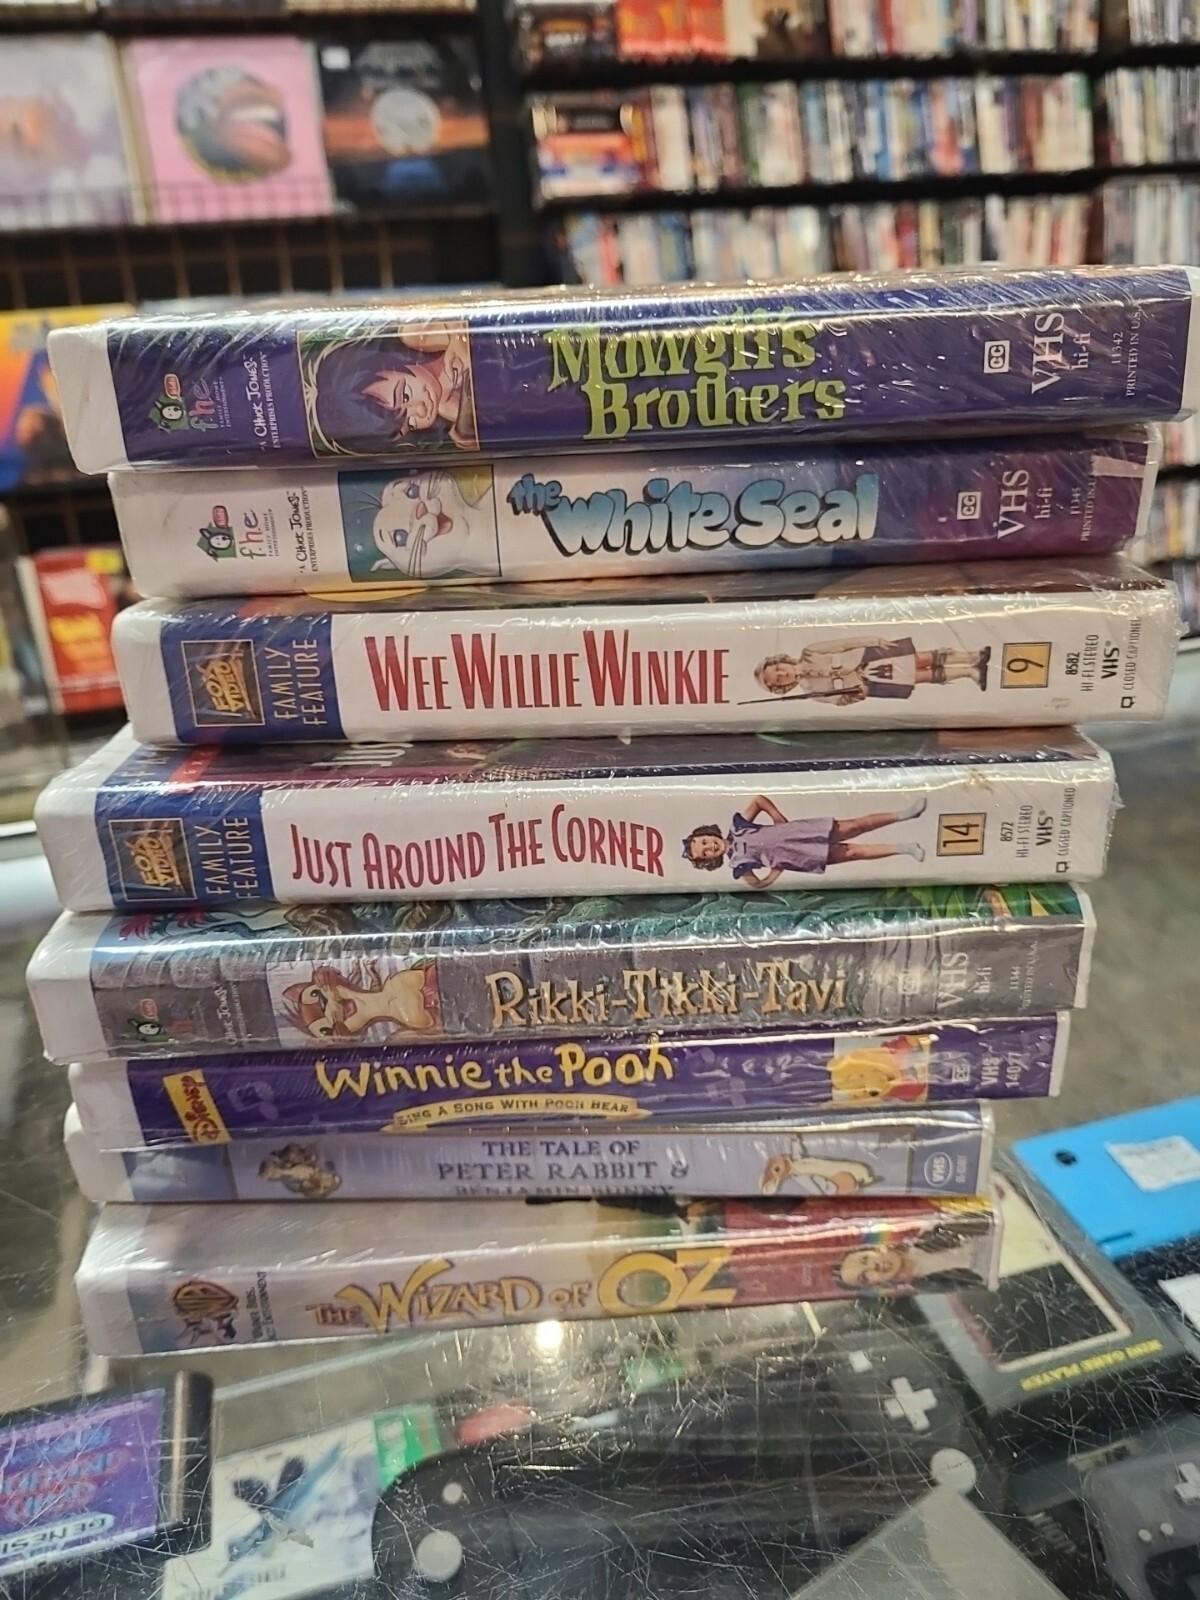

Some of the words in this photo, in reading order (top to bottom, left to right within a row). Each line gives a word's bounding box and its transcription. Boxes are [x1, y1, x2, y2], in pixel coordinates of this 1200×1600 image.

[1031, 313, 1064, 394] VHS
[1071, 332, 1091, 369] hi-fi
[1111, 331, 1123, 364] 11342
[1130, 332, 1139, 347] IN
[1126, 349, 1139, 398] PRINTED
[582, 372, 846, 439] Brothers
[507, 474, 563, 515] the
[543, 478, 732, 557] White
[734, 473, 880, 548] Seal
[997, 469, 1030, 539] VHS
[1034, 487, 1052, 519] hi-fi
[1080, 500, 1094, 541] PRINTED
[1006, 657, 1045, 674] 9
[1064, 651, 1080, 676] 8582
[1084, 633, 1100, 666] STEREO
[219, 659, 241, 713] VIDEO
[265, 648, 299, 720] FAMILY
[292, 638, 328, 726] FEATURE
[364, 635, 452, 712] WEE
[450, 632, 583, 710] WILLIE
[582, 629, 731, 707] WINKIE
[1122, 662, 1137, 691] CLOSED
[1018, 804, 1034, 835] STEREO
[1060, 787, 1077, 828] CAPTIONED
[290, 823, 352, 888] JUST
[362, 832, 486, 890] AROUND
[488, 812, 546, 872] THE
[551, 803, 665, 878] CORNER
[942, 821, 980, 848] 14
[1000, 821, 1015, 842] 8572
[1057, 828, 1072, 857] CLOSED
[148, 836, 174, 888] VIDEO
[194, 825, 231, 895] FAMILY
[223, 817, 262, 900] FEATURE
[484, 957, 848, 1029] Rikki-Tikki-Tavi
[936, 952, 970, 1010] VHS
[315, 1054, 492, 1099] Winnie
[494, 1056, 553, 1089] the
[554, 1035, 674, 1088] Pooh
[981, 1056, 1000, 1086] VHS
[438, 1105, 449, 1117] A
[454, 1101, 494, 1114] SONG
[501, 1099, 539, 1111] WITH
[481, 1141, 532, 1157] THE
[539, 1140, 606, 1157] TALE
[609, 1139, 641, 1155] OF
[437, 1162, 534, 1182] PETER
[548, 1161, 659, 1181] RABBIT
[931, 1155, 947, 1184] VHS
[335, 1257, 544, 1335] WIZARD
[596, 1246, 738, 1315] OZ
